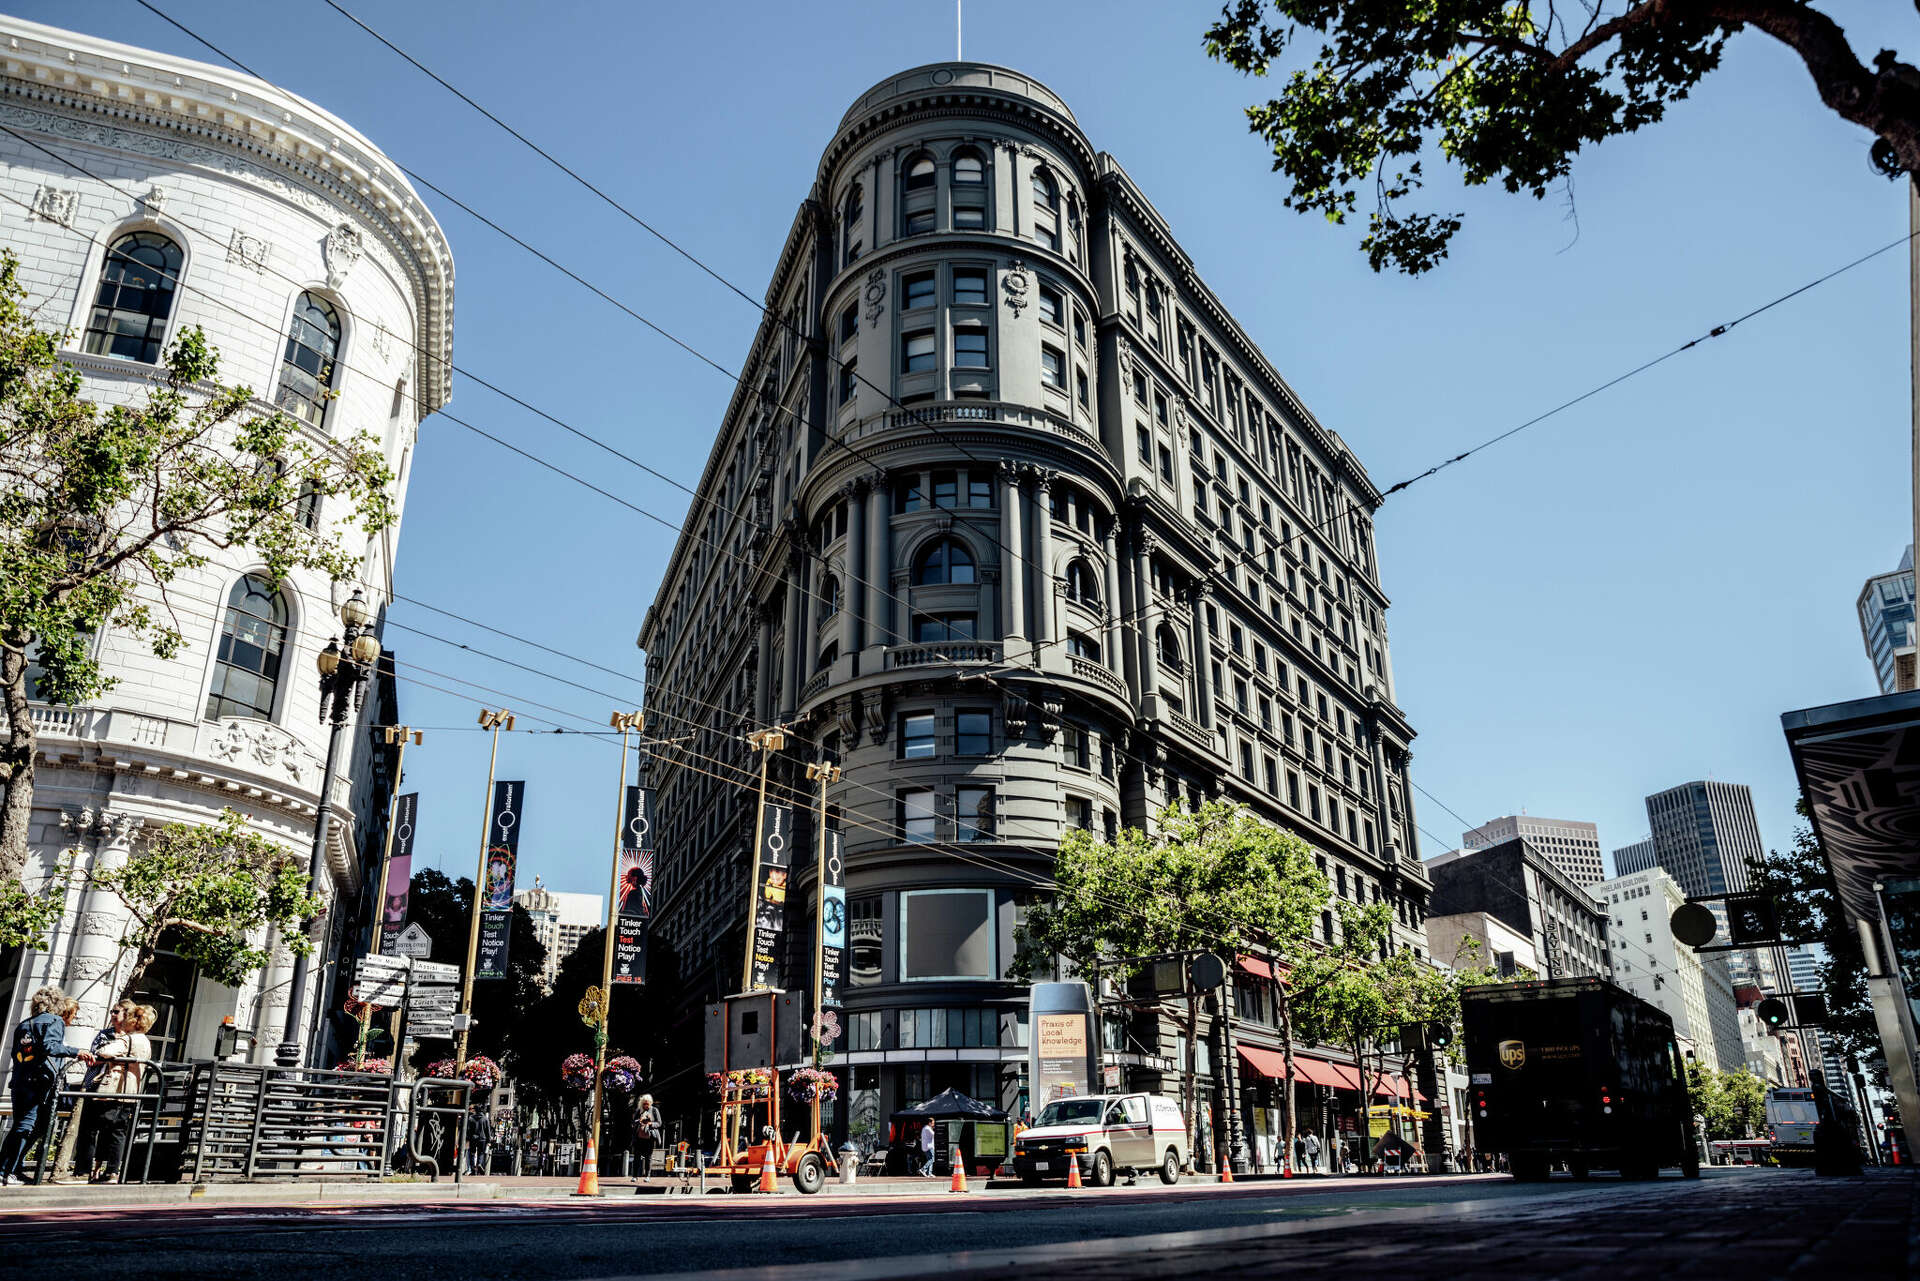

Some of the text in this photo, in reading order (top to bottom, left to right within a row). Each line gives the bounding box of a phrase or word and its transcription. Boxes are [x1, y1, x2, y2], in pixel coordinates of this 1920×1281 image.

[484, 913, 505, 921] Tinker
[484, 922, 504, 930] Touch
[620, 918, 642, 928] Tinker
[483, 930, 497, 938] Test
[620, 926, 641, 936] Touch
[757, 929, 776, 939] Tinker
[482, 939, 504, 947] Notice
[619, 935, 634, 944] Test
[757, 937, 775, 947] Touch
[481, 947, 498, 957] Play!
[618, 943, 641, 953] Notice
[756, 944, 769, 954] Test
[825, 947, 840, 956] Tinker
[617, 951, 635, 962] Play!
[755, 952, 775, 964] Notice
[824, 955, 839, 964] Touch
[754, 960, 769, 971] Play!
[823, 962, 834, 970] Test
[823, 970, 840, 979] Notice
[823, 977, 836, 987] Play!
[1041, 1020, 1065, 1028] Praxis
[1042, 1037, 1082, 1045] Knowledge
[1501, 1048, 1524, 1065] ups
